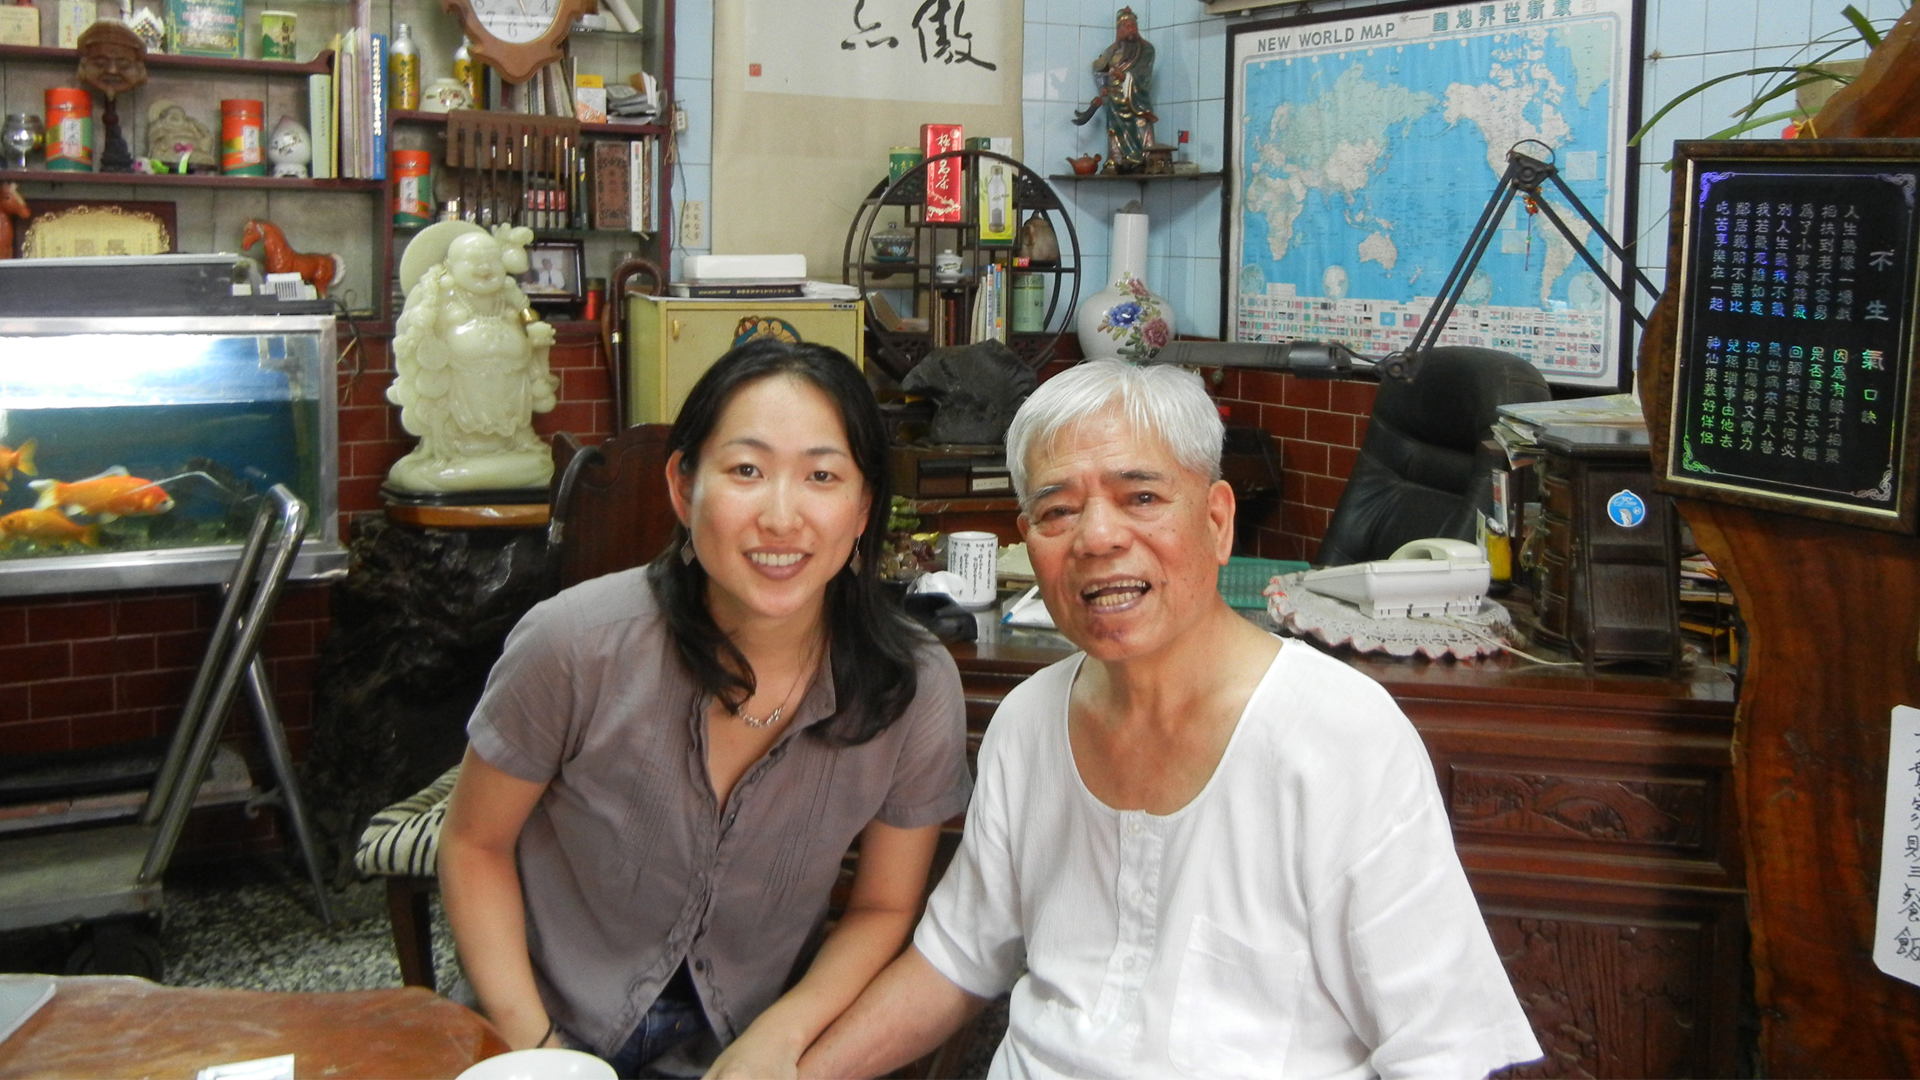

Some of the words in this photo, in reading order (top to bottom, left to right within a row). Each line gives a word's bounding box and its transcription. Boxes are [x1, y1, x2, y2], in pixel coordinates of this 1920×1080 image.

[486, 11, 495, 27] 7
[508, 22, 517, 38] 6
[1257, 35, 1291, 52] NEW
[1299, 27, 1355, 48] WORLD
[1360, 22, 1395, 40] MAP
